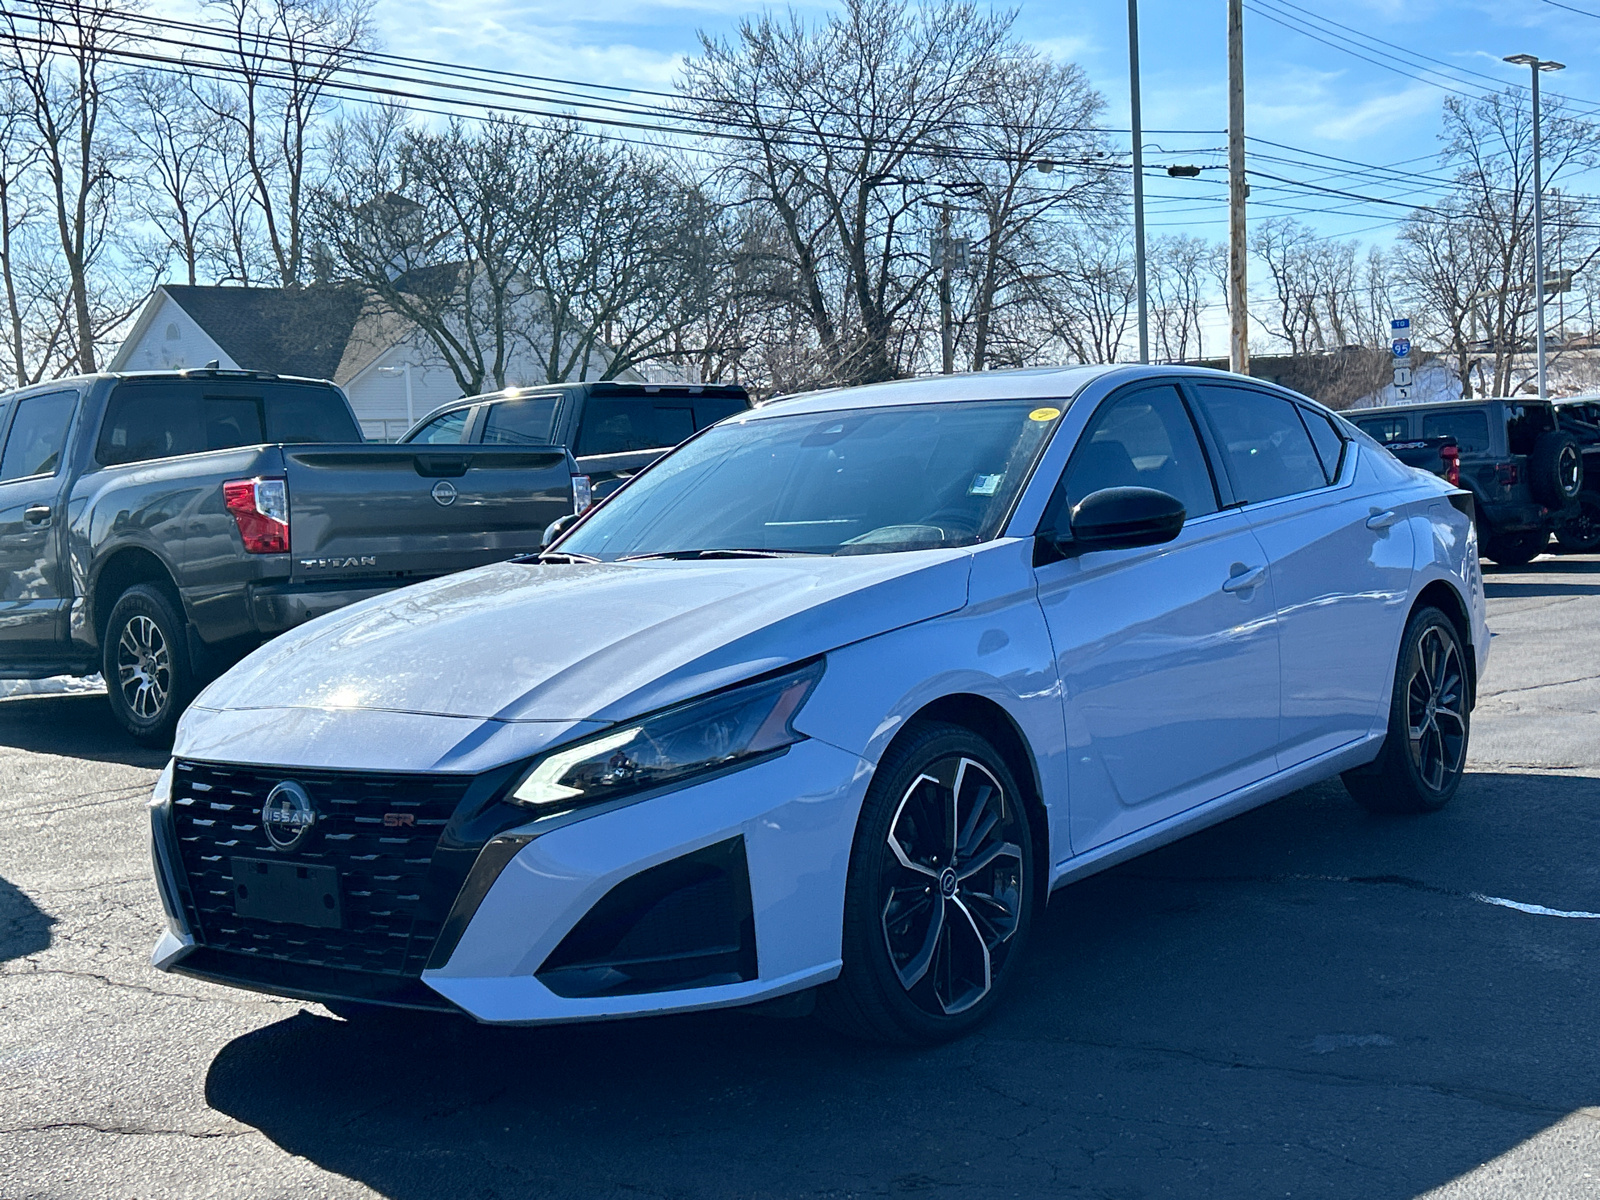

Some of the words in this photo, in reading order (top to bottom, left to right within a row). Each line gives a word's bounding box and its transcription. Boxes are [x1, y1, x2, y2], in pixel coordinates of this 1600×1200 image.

[1395, 320, 1406, 328] TO
[1394, 344, 1409, 354] 95
[300, 556, 376, 570] TITAN
[262, 807, 314, 823] NISSAN
[383, 812, 415, 827] SR
